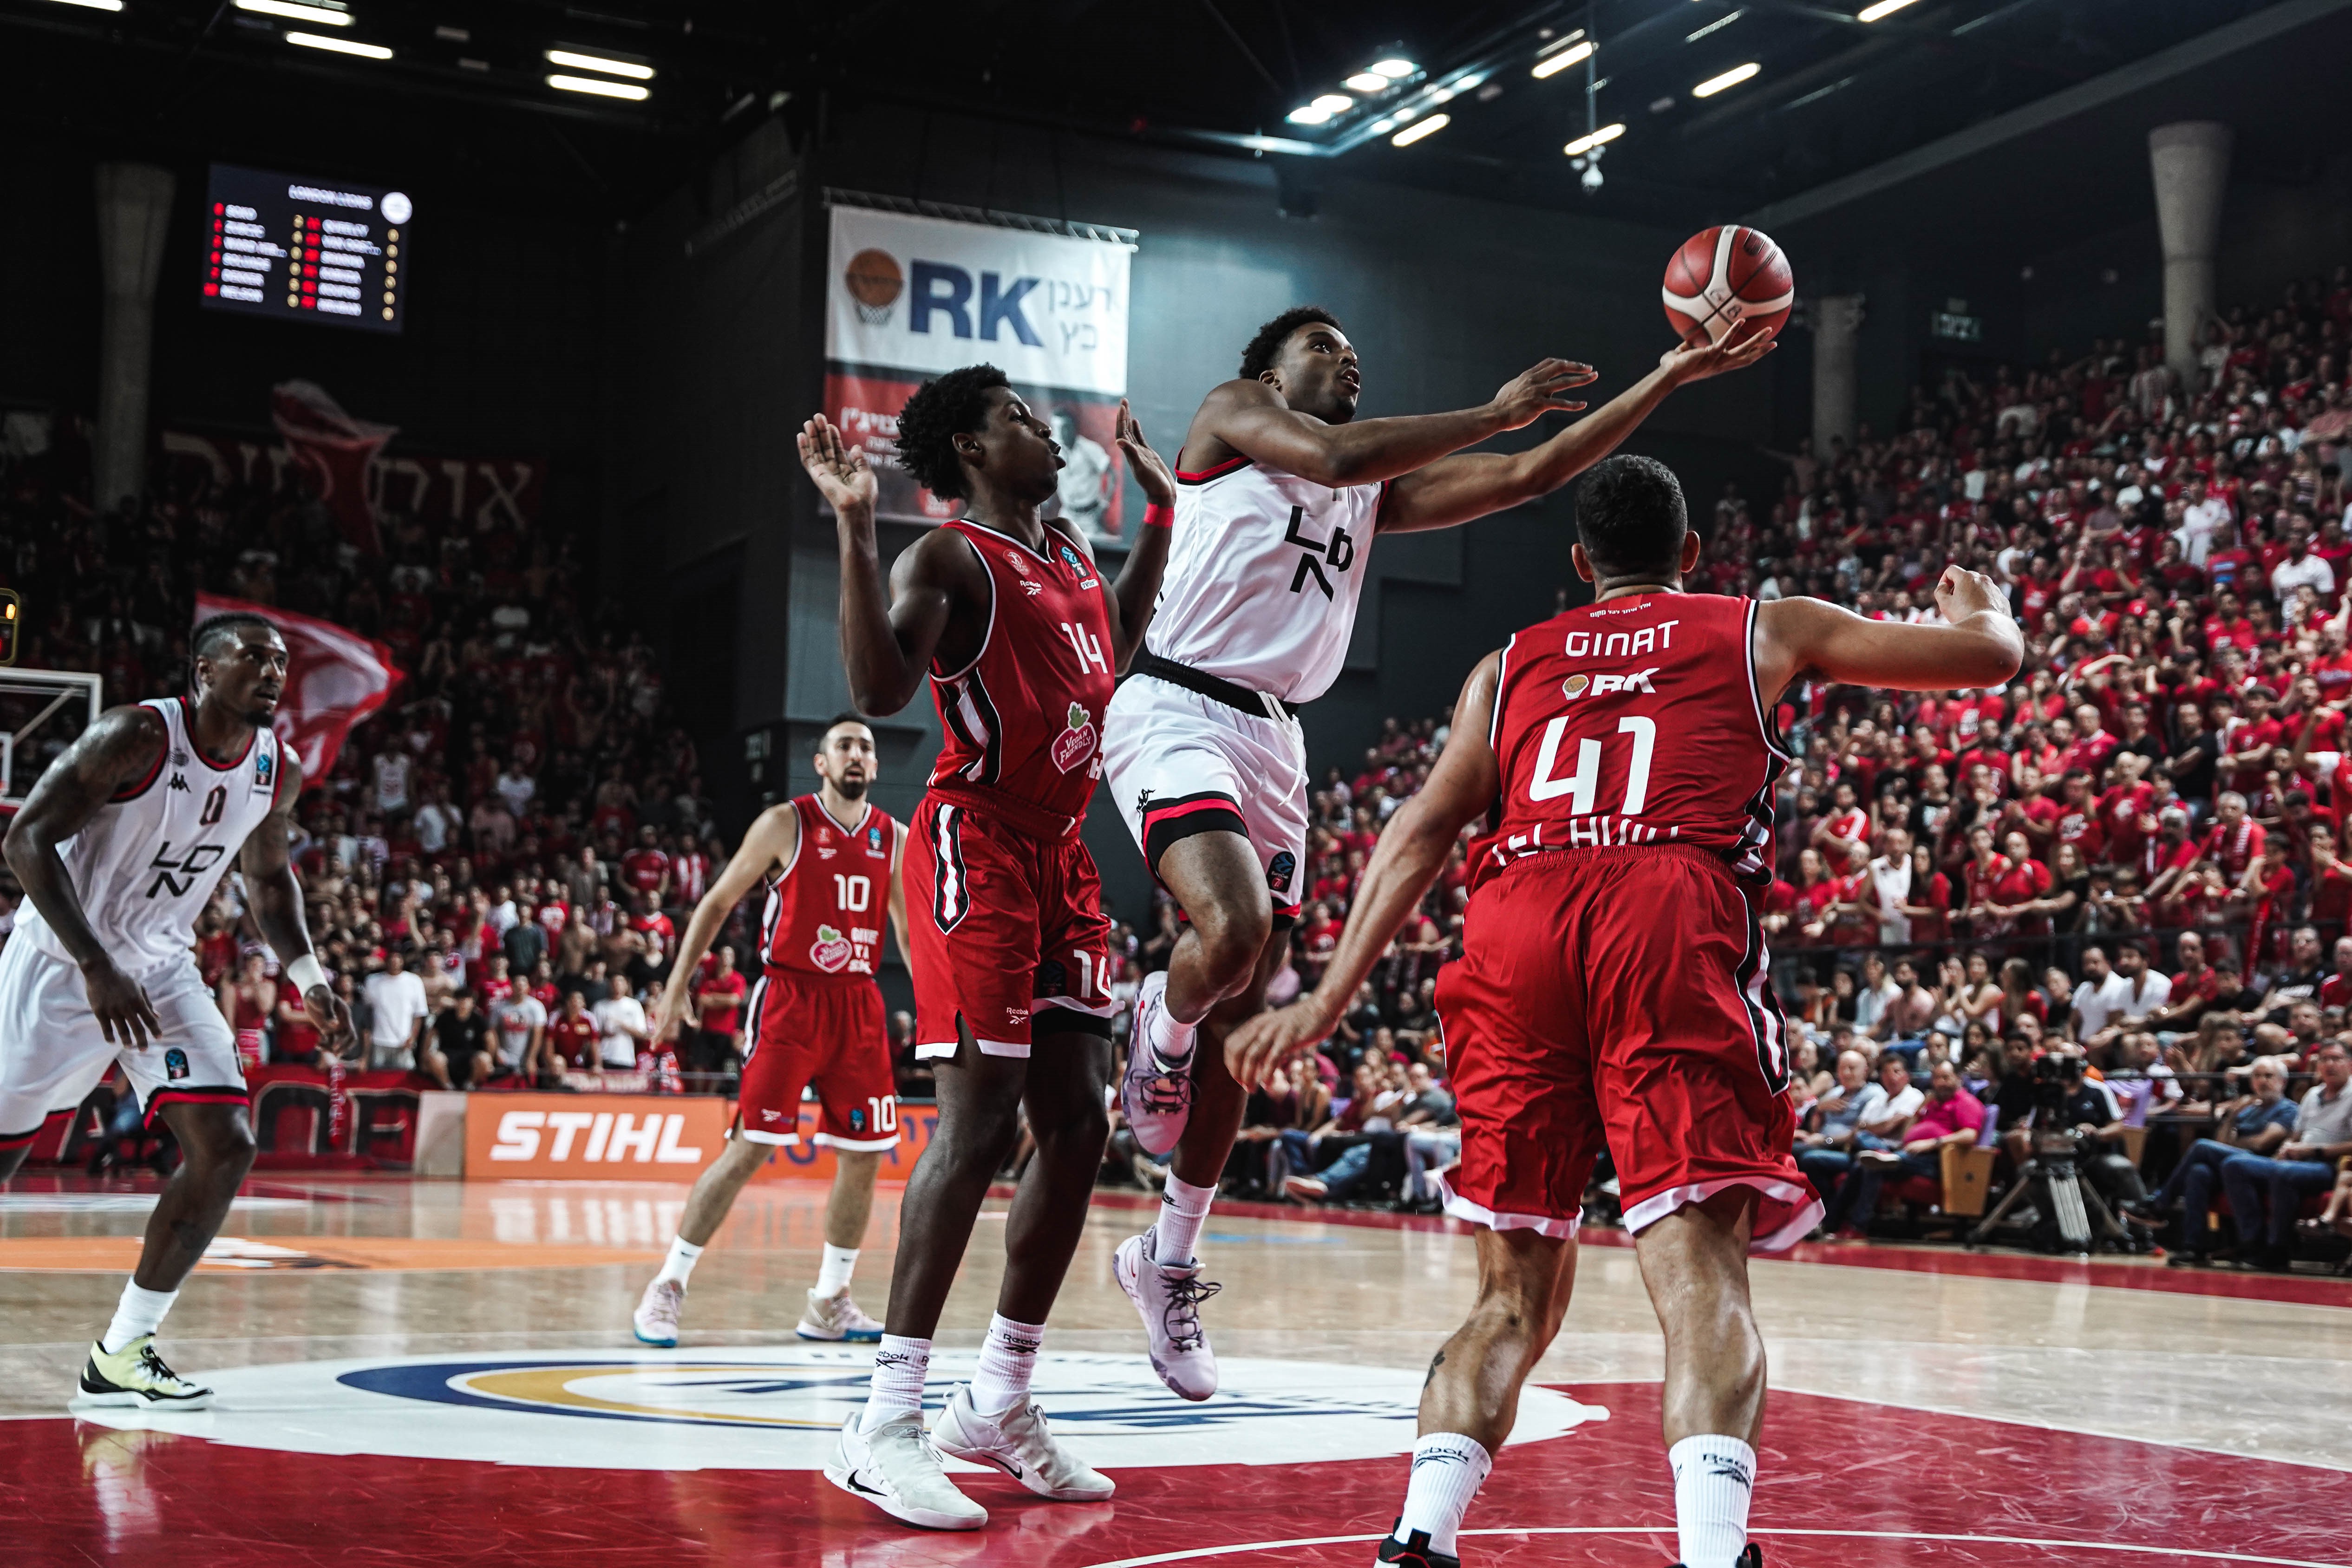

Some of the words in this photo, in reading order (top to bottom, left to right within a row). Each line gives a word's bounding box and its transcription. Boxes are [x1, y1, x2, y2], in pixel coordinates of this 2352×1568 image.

[910, 258, 1043, 347] RK
[1046, 280, 1111, 312] רענן
[1061, 321, 1098, 353] כץ
[1061, 622, 1108, 674] 14
[1565, 620, 1679, 657] GINAT
[1590, 667, 1660, 696] RK
[1060, 736, 1091, 764] FRIENDLY
[1529, 715, 1656, 815] 41
[200, 784, 227, 826] 0
[834, 874, 870, 912] 10
[868, 1095, 896, 1133] 10
[489, 1111, 702, 1163] STIHL
